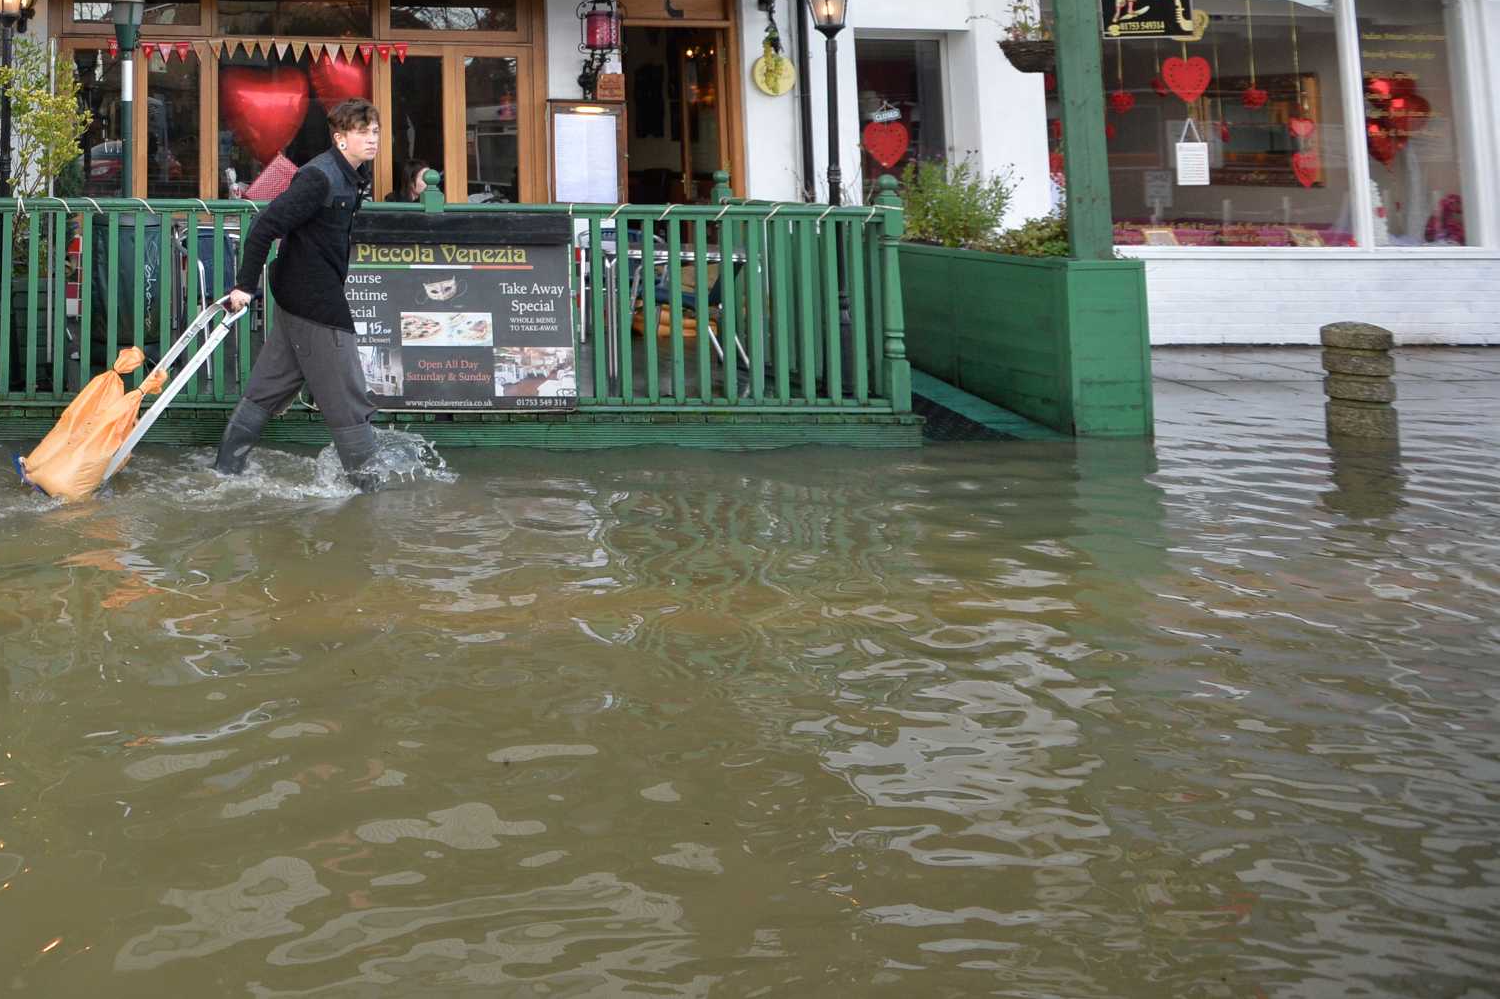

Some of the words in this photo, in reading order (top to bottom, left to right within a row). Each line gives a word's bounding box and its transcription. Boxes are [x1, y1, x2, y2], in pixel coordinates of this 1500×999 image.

[355, 243, 434, 263] Piccola
[440, 243, 527, 264] Venezia
[346, 274, 381, 284] ourse
[498, 282, 527, 294] Take
[531, 283, 564, 298] Away
[349, 305, 376, 318] ecial
[511, 299, 554, 315] Special
[418, 360, 443, 371] Open
[445, 360, 459, 369] All
[461, 360, 479, 370] Day
[406, 372, 446, 382] Saturday
[459, 373, 492, 384] Sunday
[516, 398, 538, 406] 01753
[555, 399, 567, 407] 314
